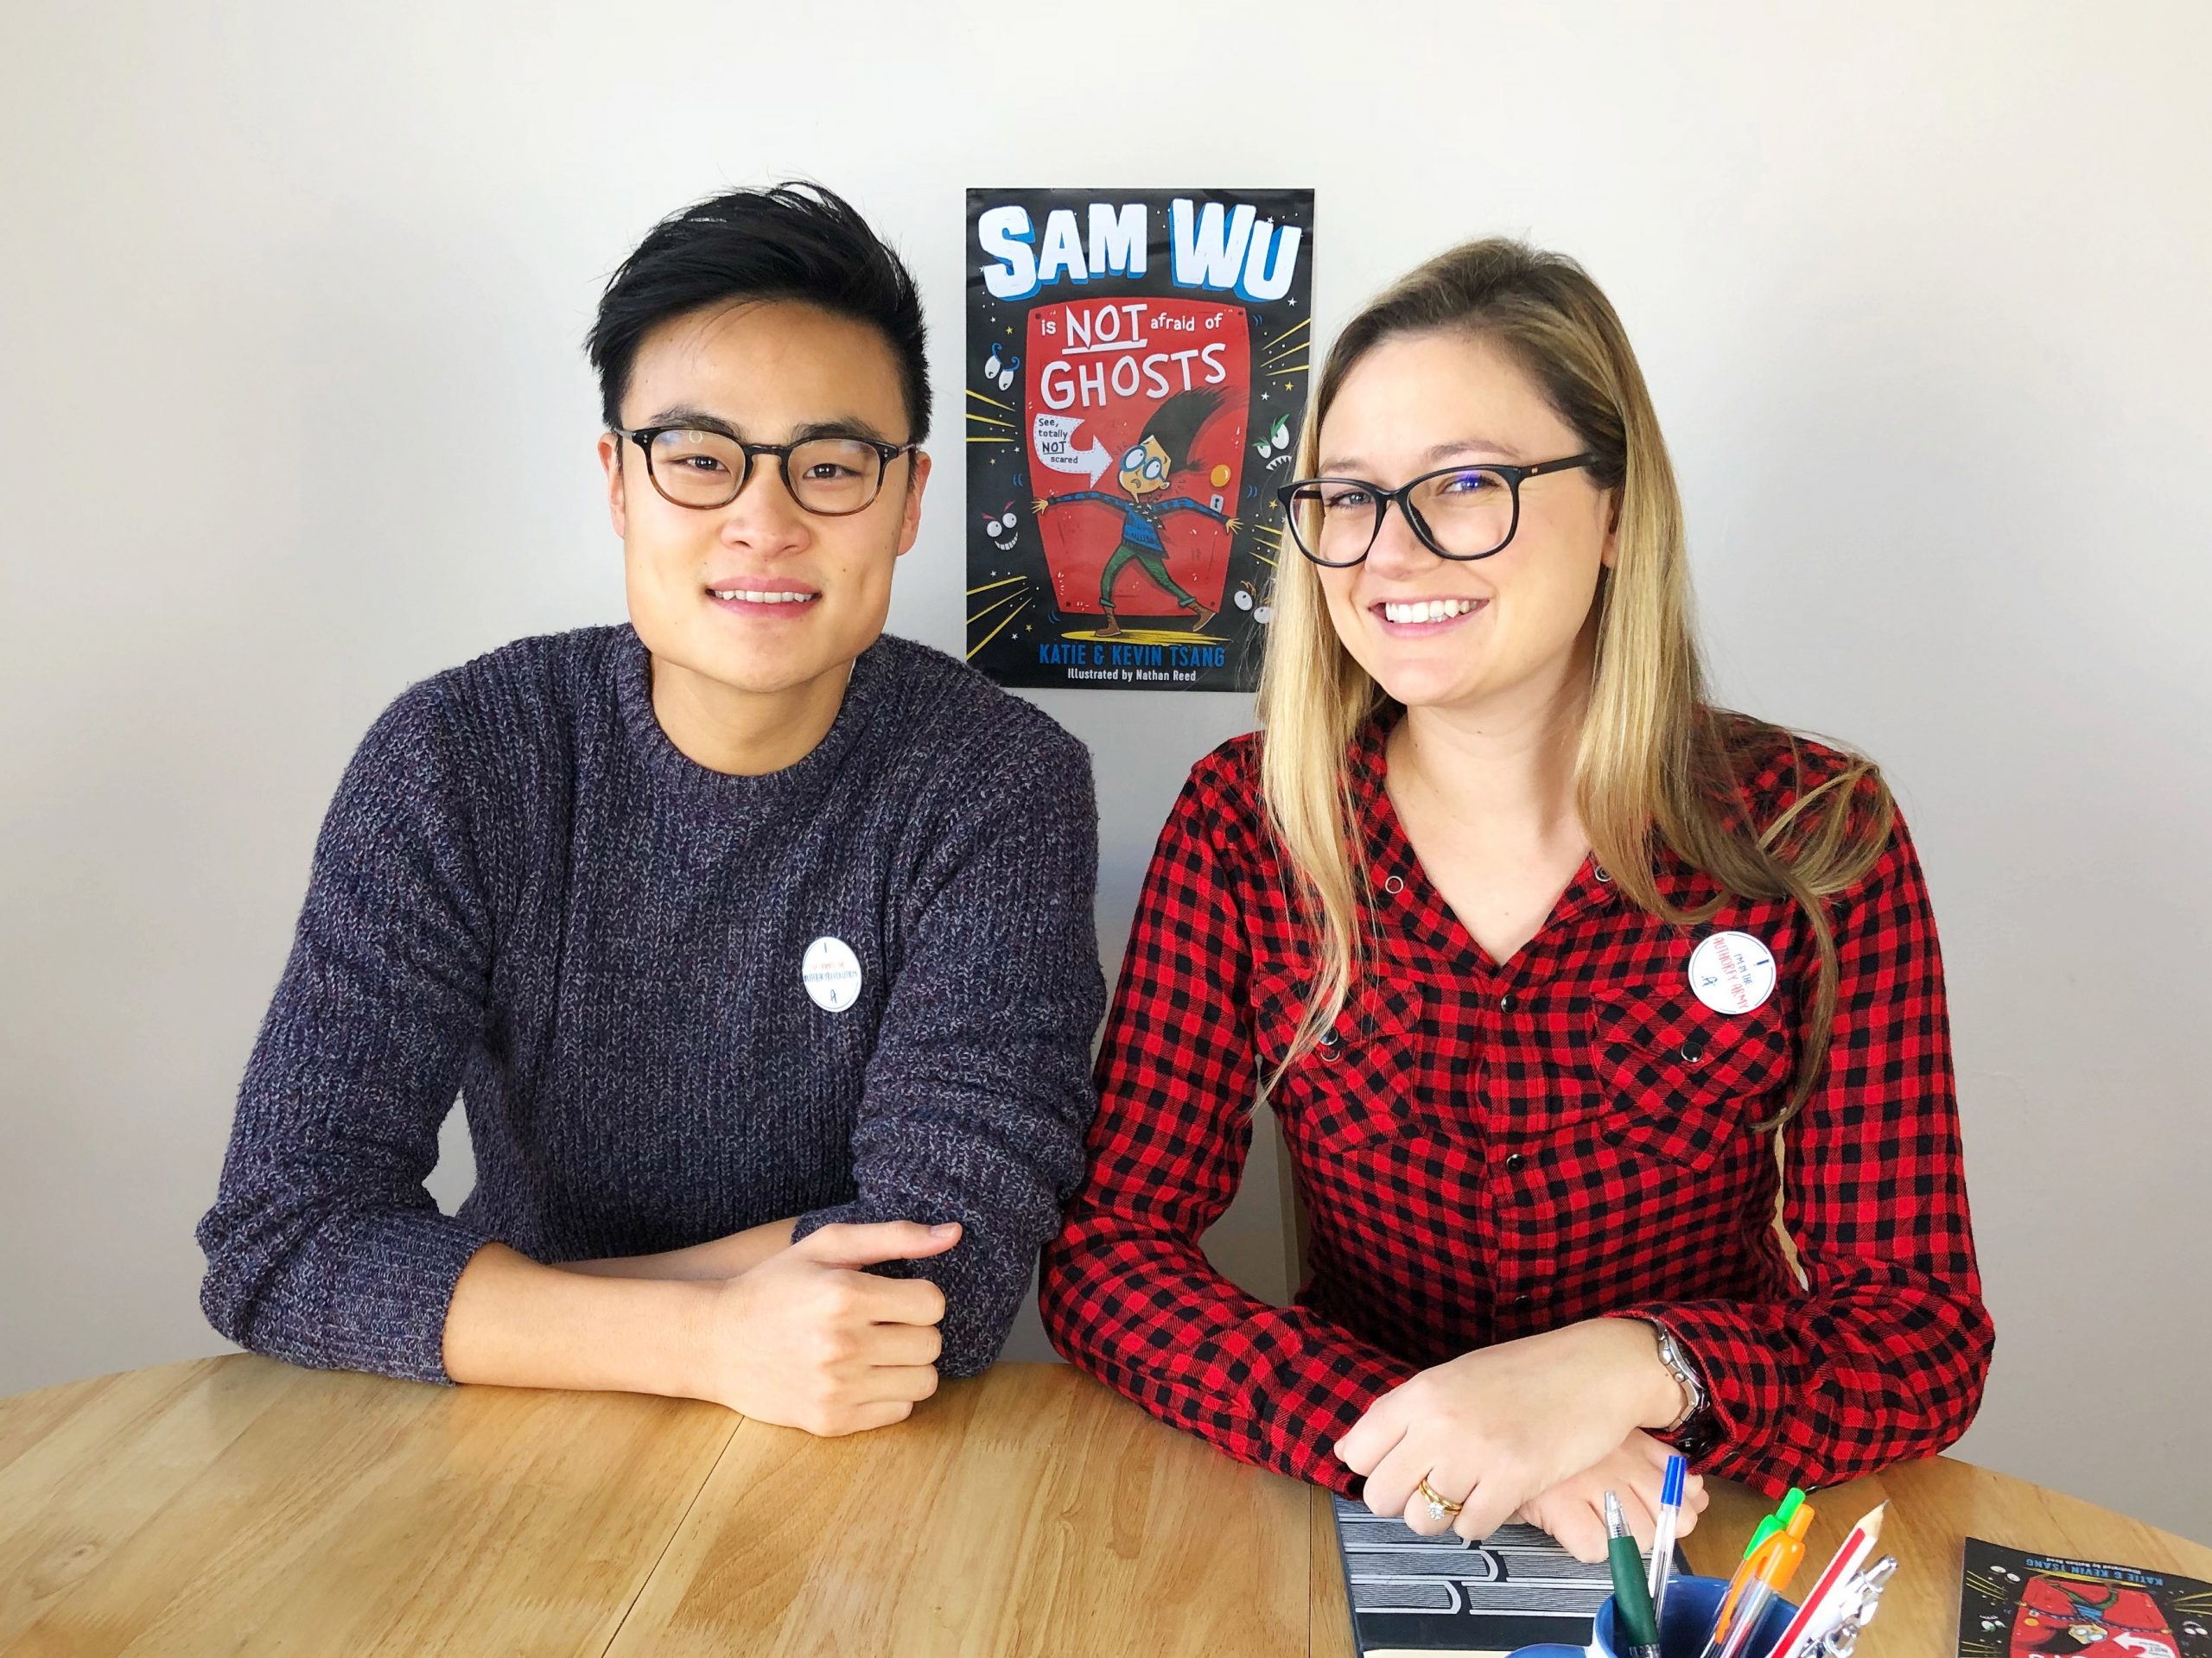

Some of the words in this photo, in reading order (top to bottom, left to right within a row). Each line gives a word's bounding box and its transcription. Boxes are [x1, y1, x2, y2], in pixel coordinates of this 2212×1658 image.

[977, 202, 1148, 302] SAM
[1168, 198, 1302, 302] WU
[1040, 317, 1057, 335] is
[1062, 303, 1148, 353] NOT
[1150, 312, 1195, 332] afraid
[1205, 312, 1224, 330] of
[1040, 343, 1228, 410] GHOSTS
[1039, 418, 1059, 427] See,
[1039, 429, 1068, 440] totally
[1042, 441, 1066, 454] NOT
[1051, 455, 1078, 464] scared
[1039, 644, 1087, 665] KATIE
[1093, 644, 1104, 665] &
[1112, 645, 1162, 667] KEVIN
[1169, 646, 1225, 667] TSANG
[1067, 668, 1119, 681] Illustrated
[1122, 670, 1133, 683] by
[1135, 669, 1169, 681] Nathan
[1173, 669, 1197, 682] Reed
[1730, 983, 1750, 1009] ARMY
[2025, 1559, 2066, 1572] TSANG
[2070, 1566, 2109, 1577] KEVIN
[2126, 1572, 2164, 1586] KATIE
